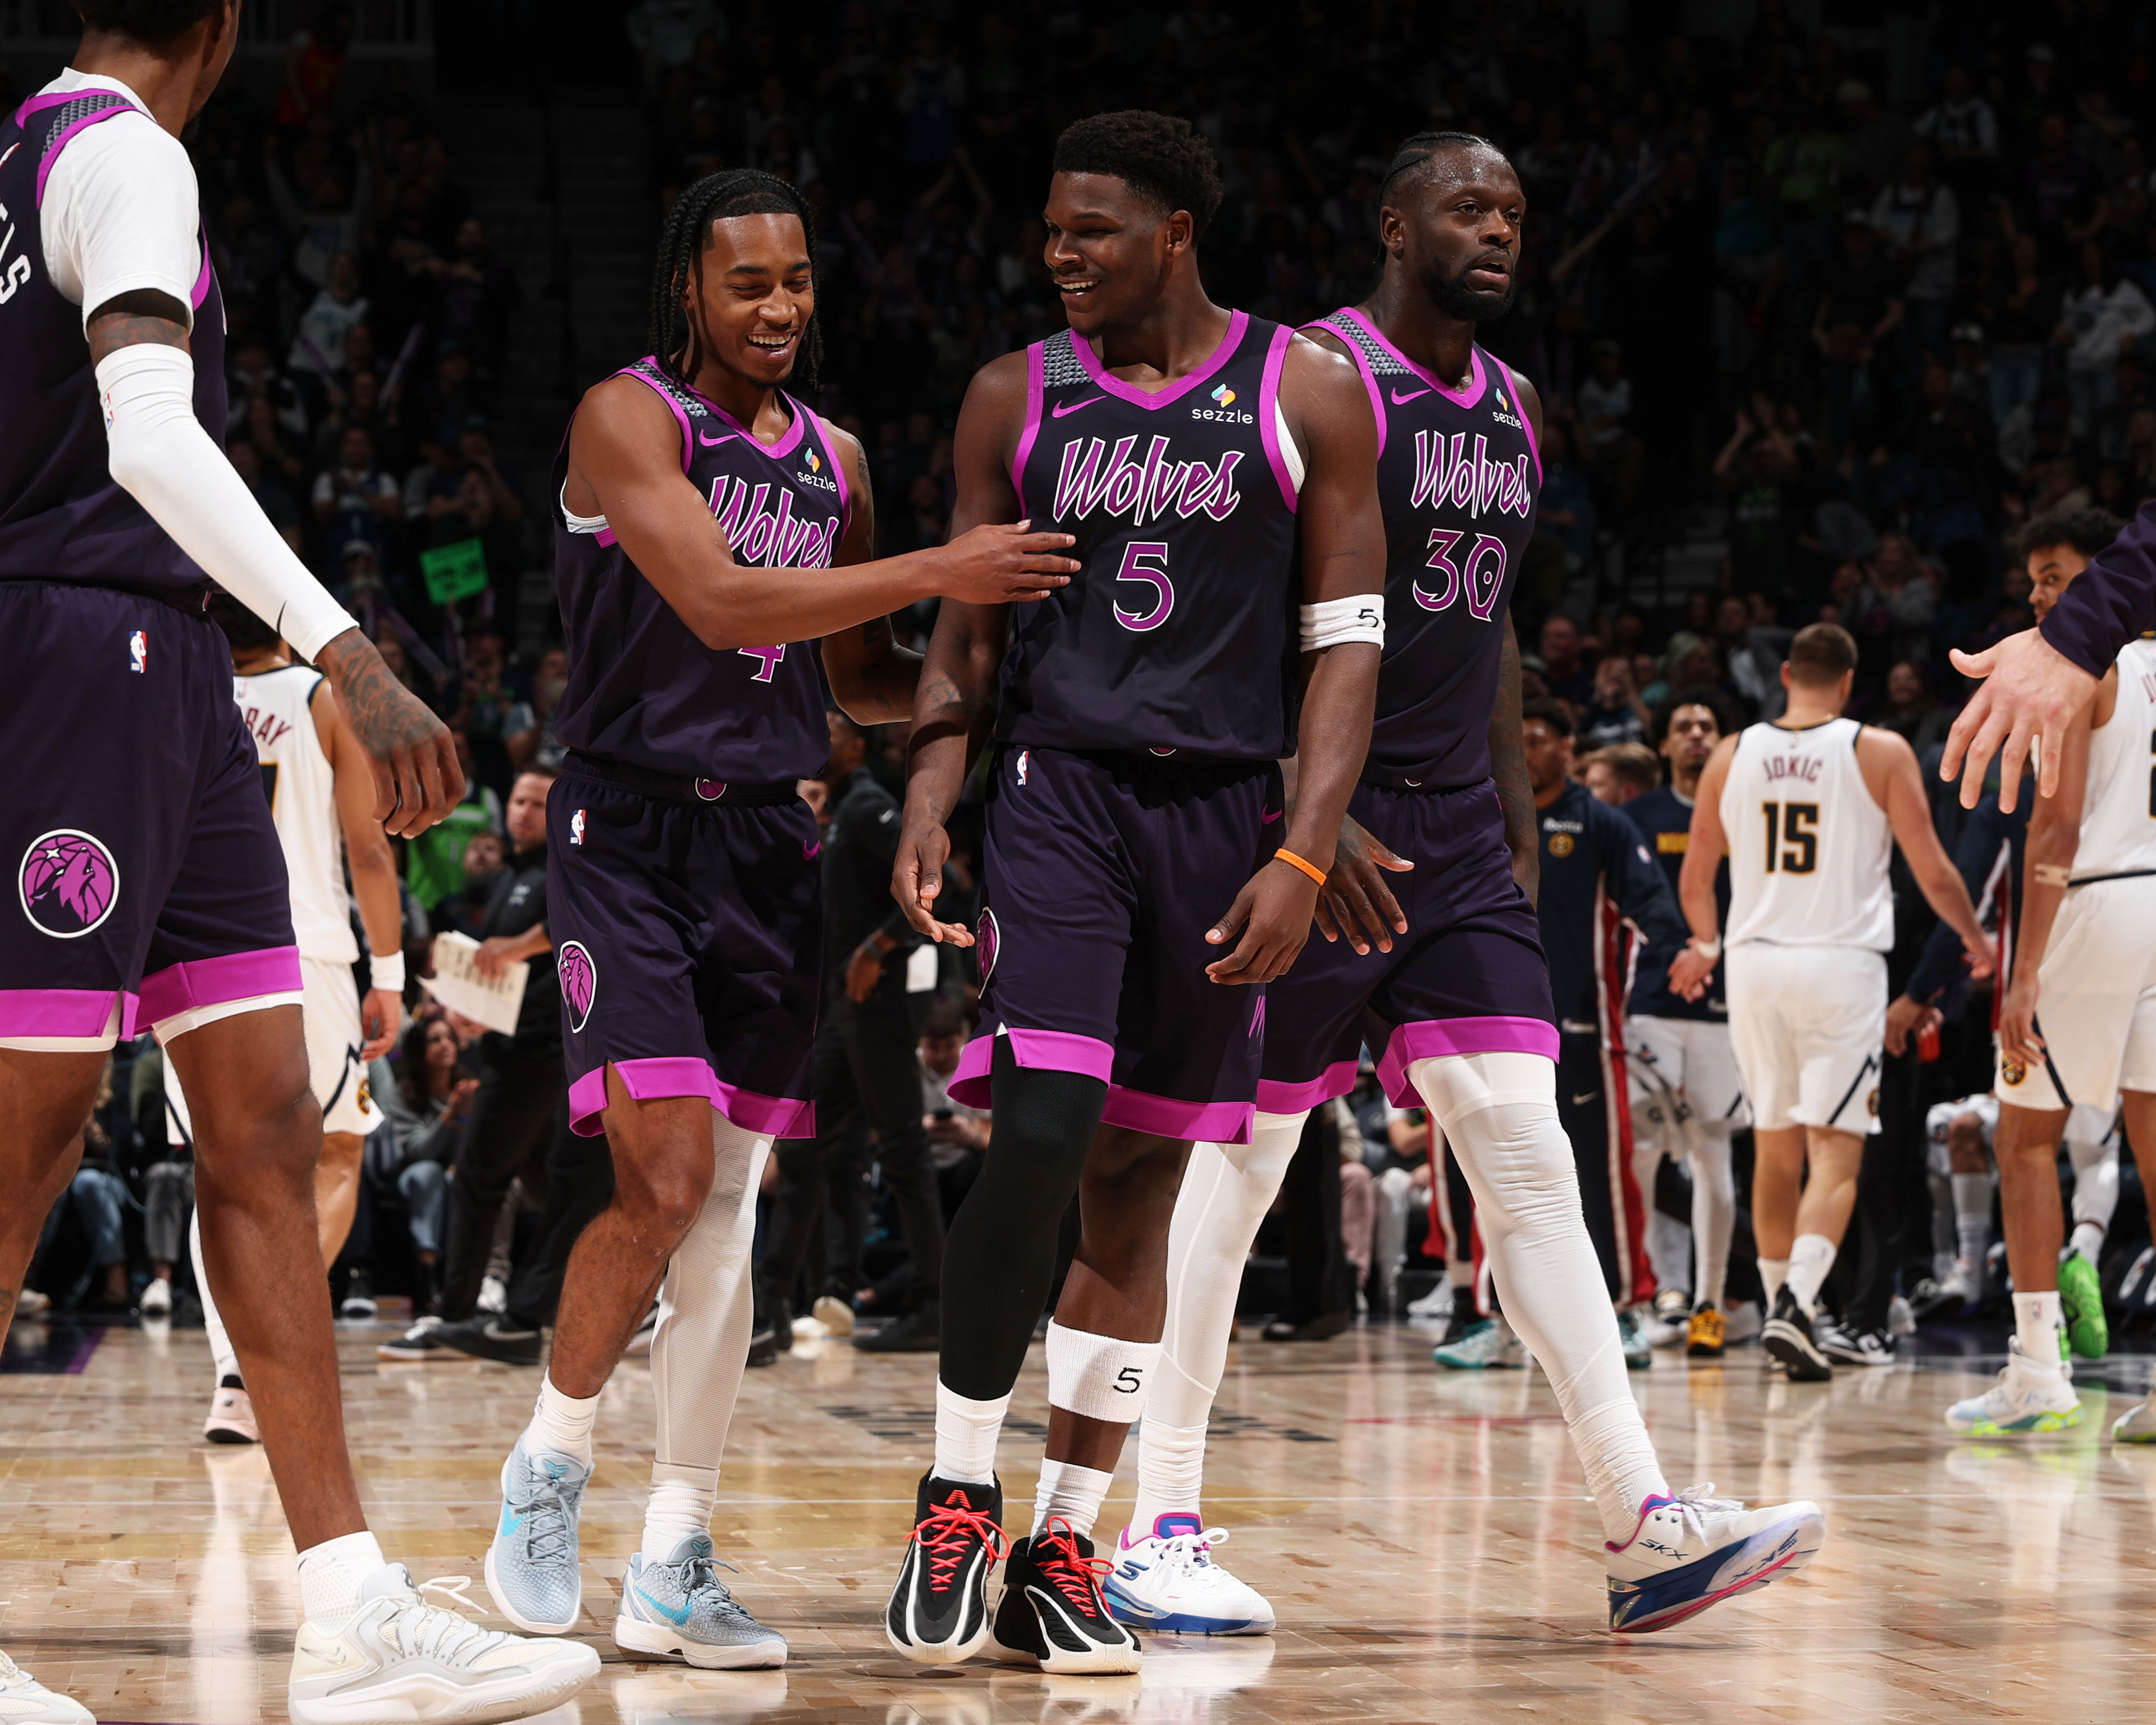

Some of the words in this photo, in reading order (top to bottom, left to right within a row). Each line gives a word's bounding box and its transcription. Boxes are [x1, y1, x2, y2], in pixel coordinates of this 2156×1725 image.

[1191, 407, 1254, 425] sezzle
[1492, 410, 1522, 430] sezzle
[797, 471, 837, 492] sezzle
[1053, 433, 1246, 527] Wolves
[1410, 429, 1531, 519] Wolves
[708, 474, 840, 569] Wolves
[1113, 541, 1175, 632] 5
[1412, 528, 1507, 623] 30
[1358, 609, 1379, 628] 5
[1761, 800, 1820, 875] 15
[1112, 1367, 1143, 1393] 5
[1638, 1538, 1689, 1561] SKX
